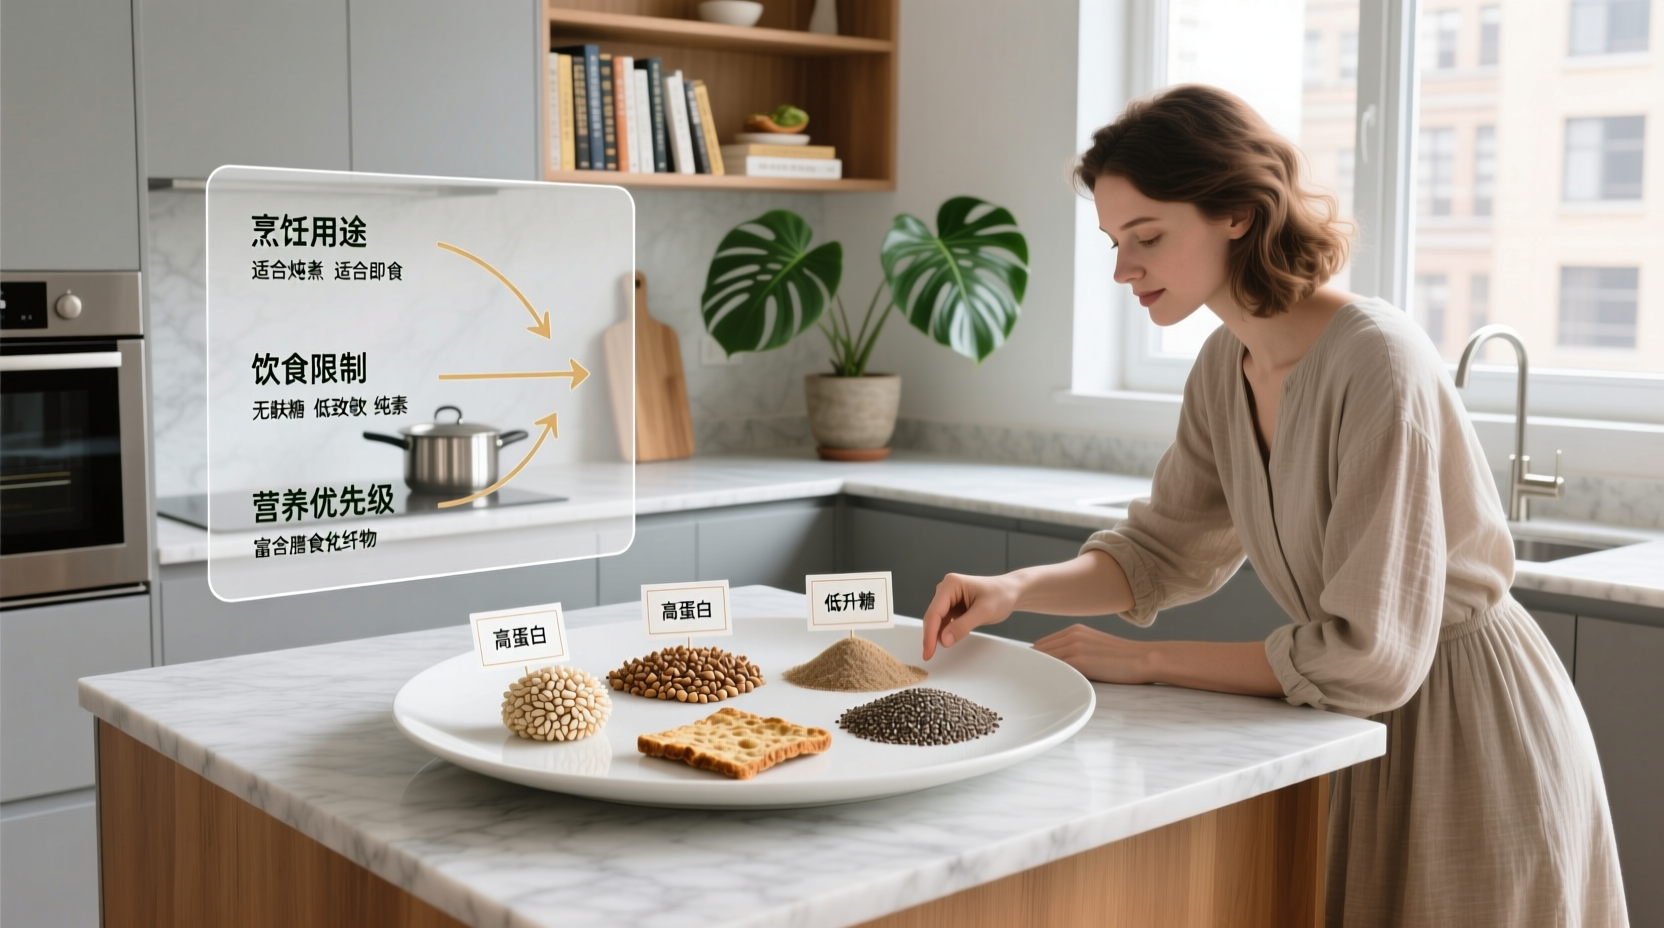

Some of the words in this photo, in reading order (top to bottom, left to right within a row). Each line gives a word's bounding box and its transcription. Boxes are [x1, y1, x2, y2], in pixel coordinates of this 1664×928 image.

[661, 599, 712, 621] 高蛋白
[824, 590, 875, 613] 低升糖
[492, 624, 547, 651] 高蛋白
